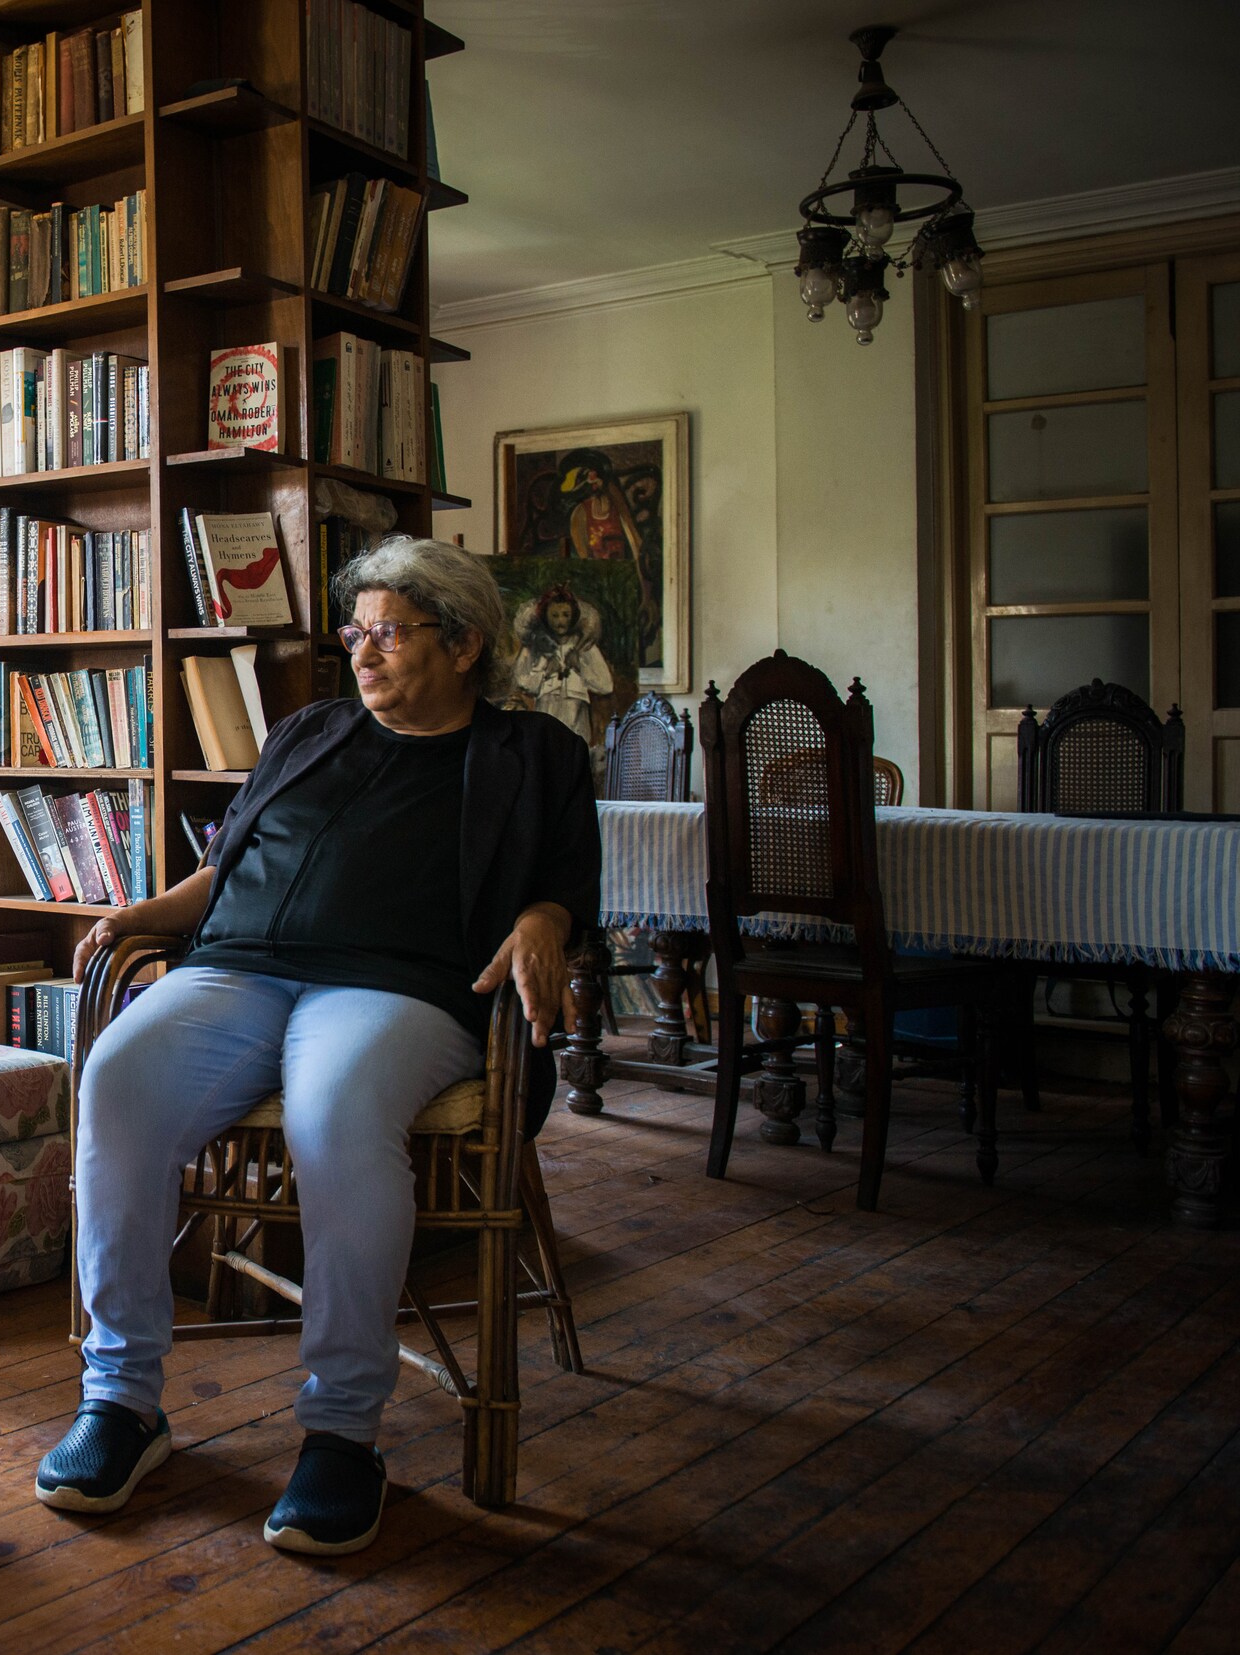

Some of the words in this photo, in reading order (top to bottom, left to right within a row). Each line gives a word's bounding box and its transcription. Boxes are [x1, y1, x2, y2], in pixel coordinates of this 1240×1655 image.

[14, 56, 23, 83] BORIS
[14, 88, 23, 141] PASTERNAK
[2, 358, 10, 399] ROSETTA
[225, 365, 243, 378] THE
[245, 362, 264, 376] CITY
[211, 382, 249, 398] ALWAYS
[251, 378, 276, 393] WINS
[211, 409, 239, 422] OMAR
[242, 405, 276, 420] ROBERT
[219, 424, 268, 439] HAMILTON
[211, 534, 272, 543] Headscarves
[0, 541, 7, 565] BOOK
[140, 548, 145, 556] We
[185, 544, 194, 563] CITY
[218, 551, 257, 562] Hymens
[0, 568, 7, 579] OF
[101, 561, 110, 589] HAROLD
[188, 563, 201, 594] ALWAYS
[0, 584, 7, 613] SANDS
[101, 589, 110, 618] ROBBINS
[195, 595, 205, 615] WINS
[146, 671, 154, 711] HARRIS
[34, 688, 44, 700] RED
[39, 700, 52, 722] DRAGON
[47, 722, 58, 741] THOMAS
[100, 803, 109, 819] BATTLE
[109, 792, 129, 811] TH
[65, 823, 86, 834] AUSTER
[67, 819, 82, 827] PAUL
[81, 802, 93, 819] TIM
[88, 819, 102, 854] WINTON
[89, 797, 100, 824] TEMPORARY
[97, 824, 106, 841] PEOPLE
[105, 818, 111, 826] OF
[107, 825, 115, 842] BEIRUT
[134, 833, 142, 854] Paolo
[135, 855, 144, 893] Bacigalupi
[55, 996, 59, 1004] NO
[11, 1007, 21, 1031] THE
